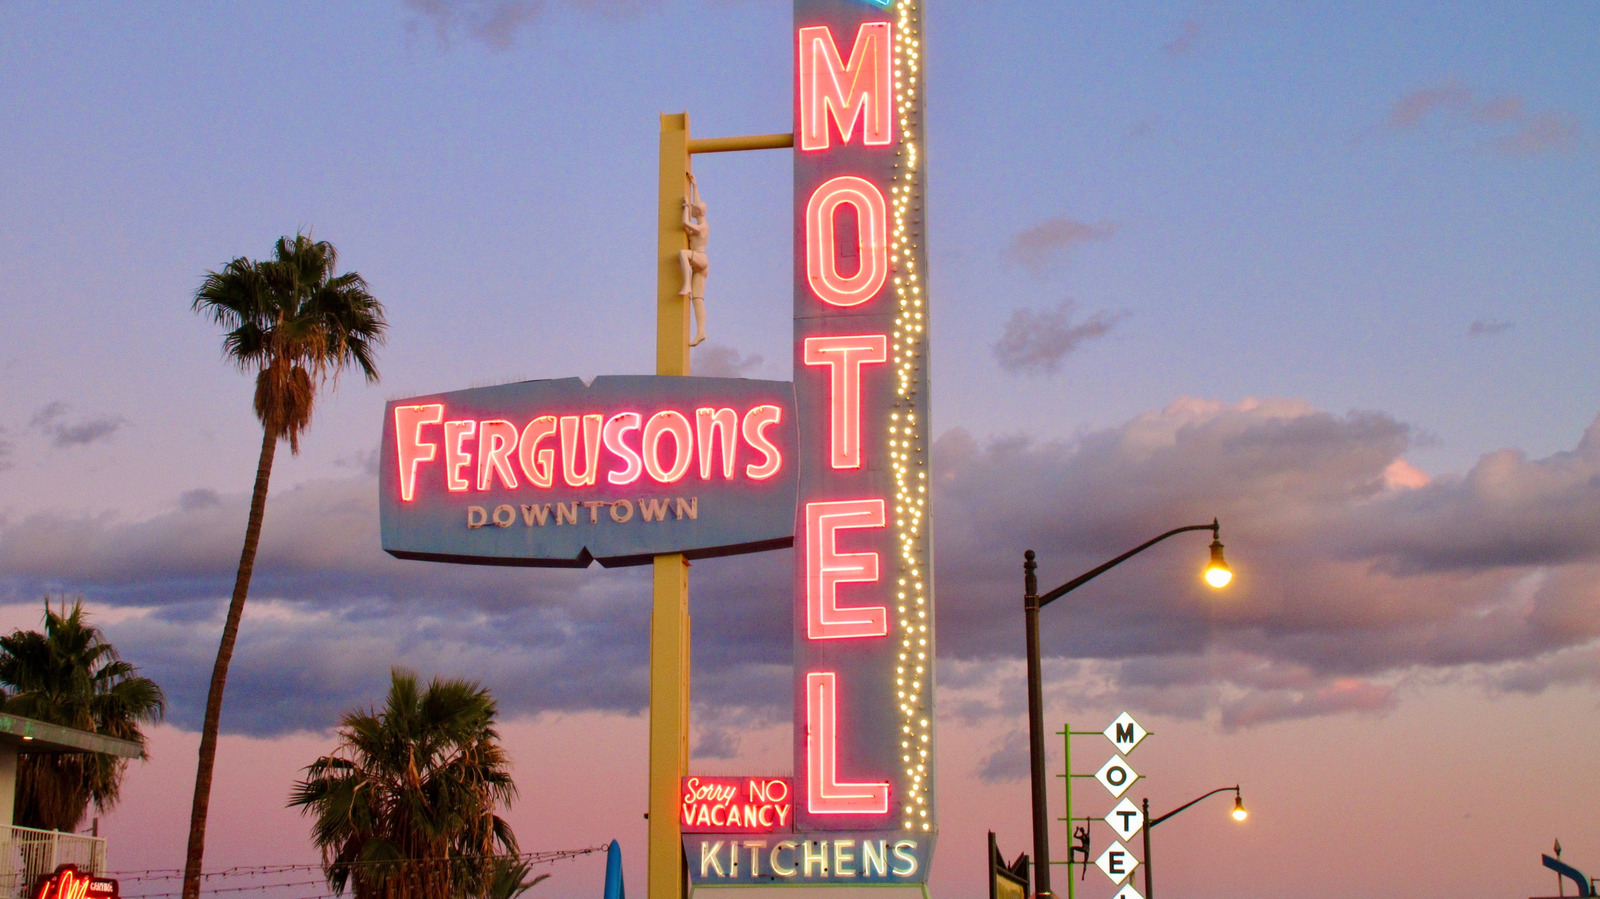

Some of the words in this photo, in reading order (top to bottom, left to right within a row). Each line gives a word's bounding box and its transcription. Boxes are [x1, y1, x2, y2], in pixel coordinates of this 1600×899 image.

[798, 21, 893, 815] MOTEL
[466, 495, 699, 530] DOWNTOWN
[685, 778, 736, 806] Sorry
[749, 779, 788, 803] NO
[1106, 722, 1137, 899] MOTE
[683, 803, 789, 827] VACANCY
[700, 839, 919, 878] KITCHENS
